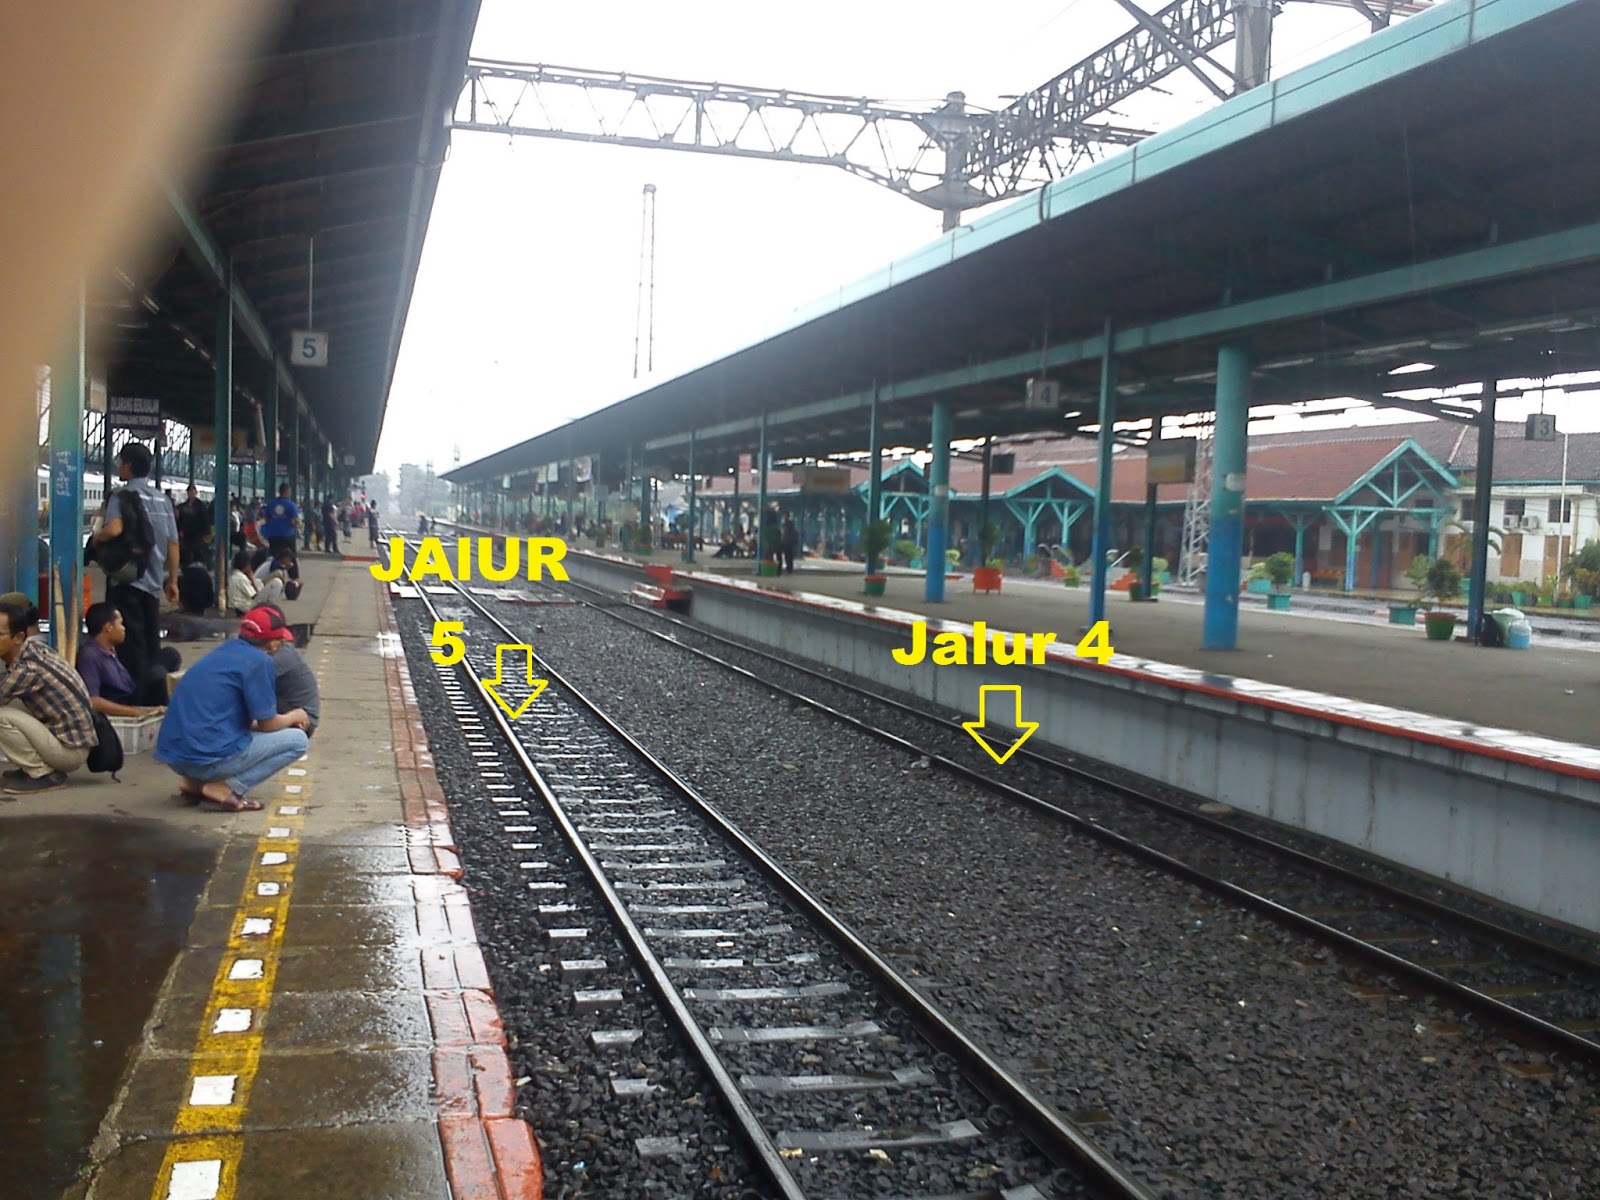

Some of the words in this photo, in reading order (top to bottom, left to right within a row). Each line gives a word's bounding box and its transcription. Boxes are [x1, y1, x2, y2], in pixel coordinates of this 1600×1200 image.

[302, 337, 317, 359] 5
[1040, 385, 1051, 404] 4
[1540, 418, 1550, 437] 3
